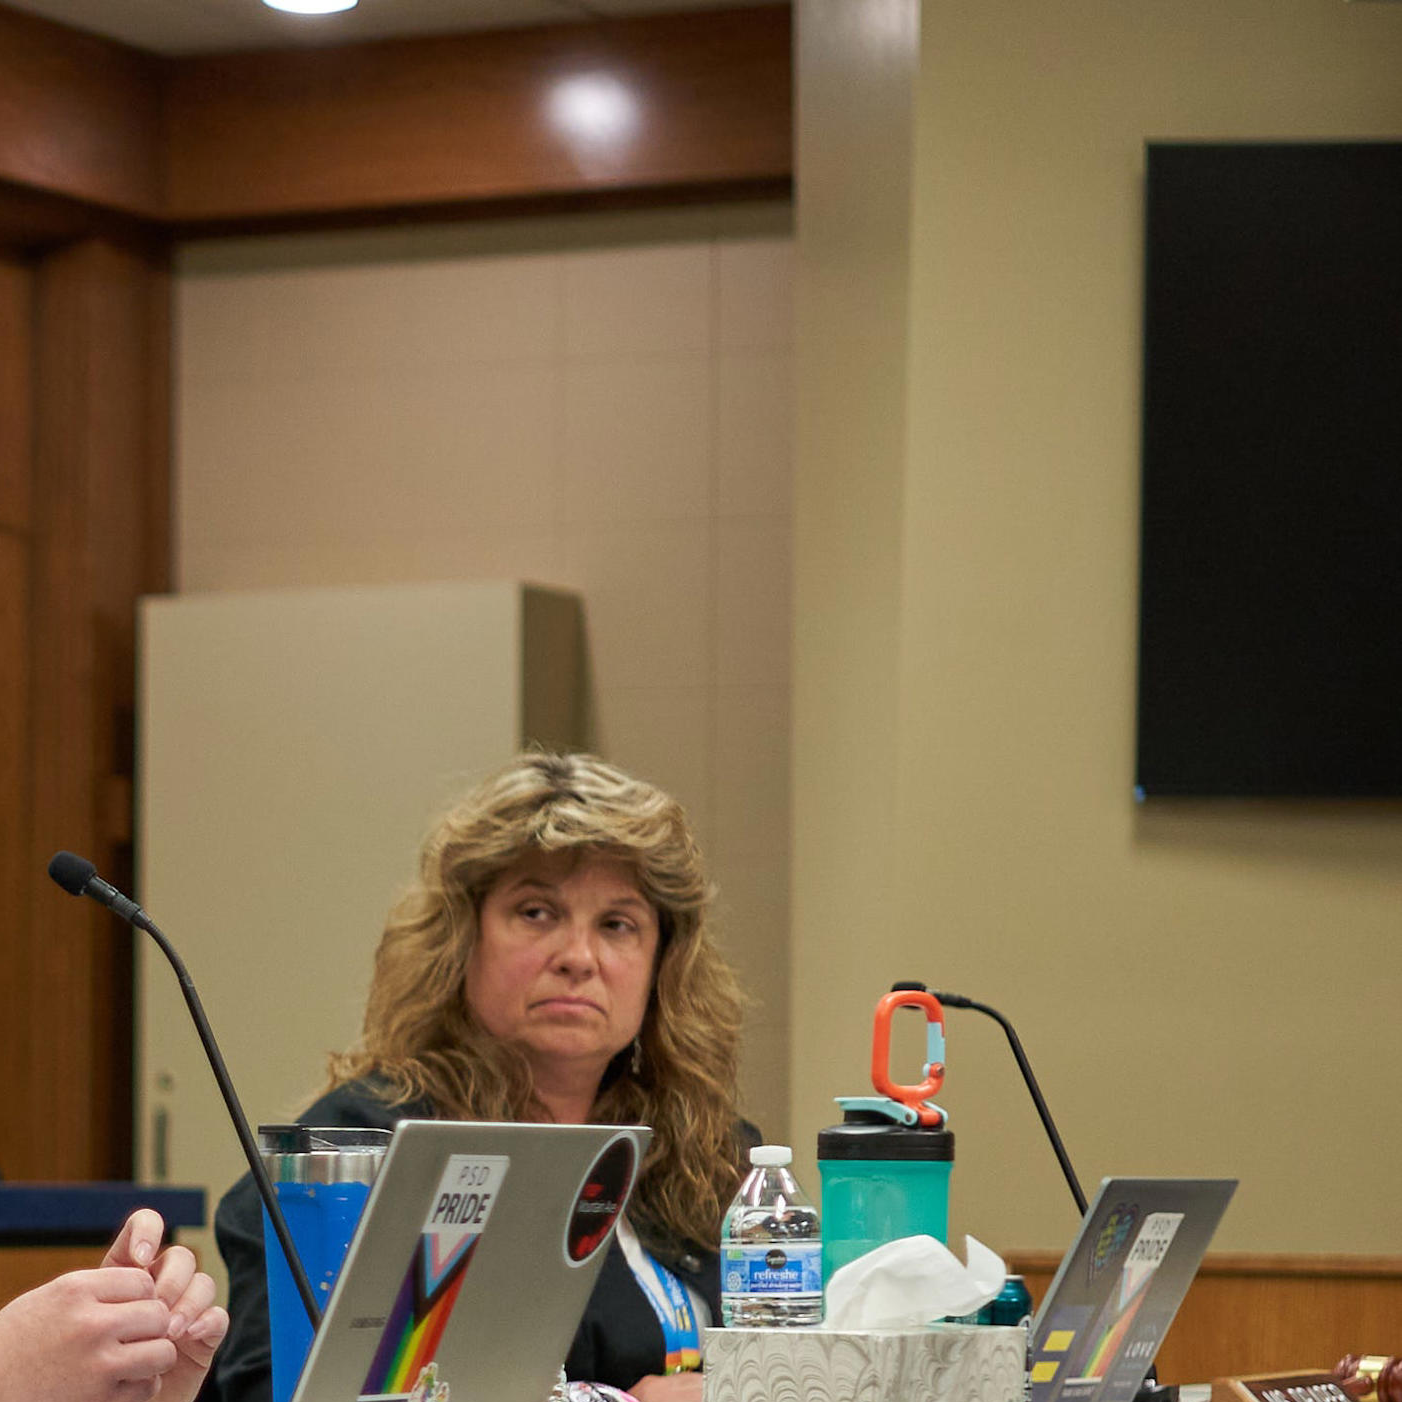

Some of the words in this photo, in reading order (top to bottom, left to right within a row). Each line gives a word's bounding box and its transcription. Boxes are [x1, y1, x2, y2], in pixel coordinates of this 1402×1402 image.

[458, 1166, 490, 1186] PSD
[431, 1193, 491, 1224] PRIDE
[1130, 1240, 1168, 1260] PRIDE
